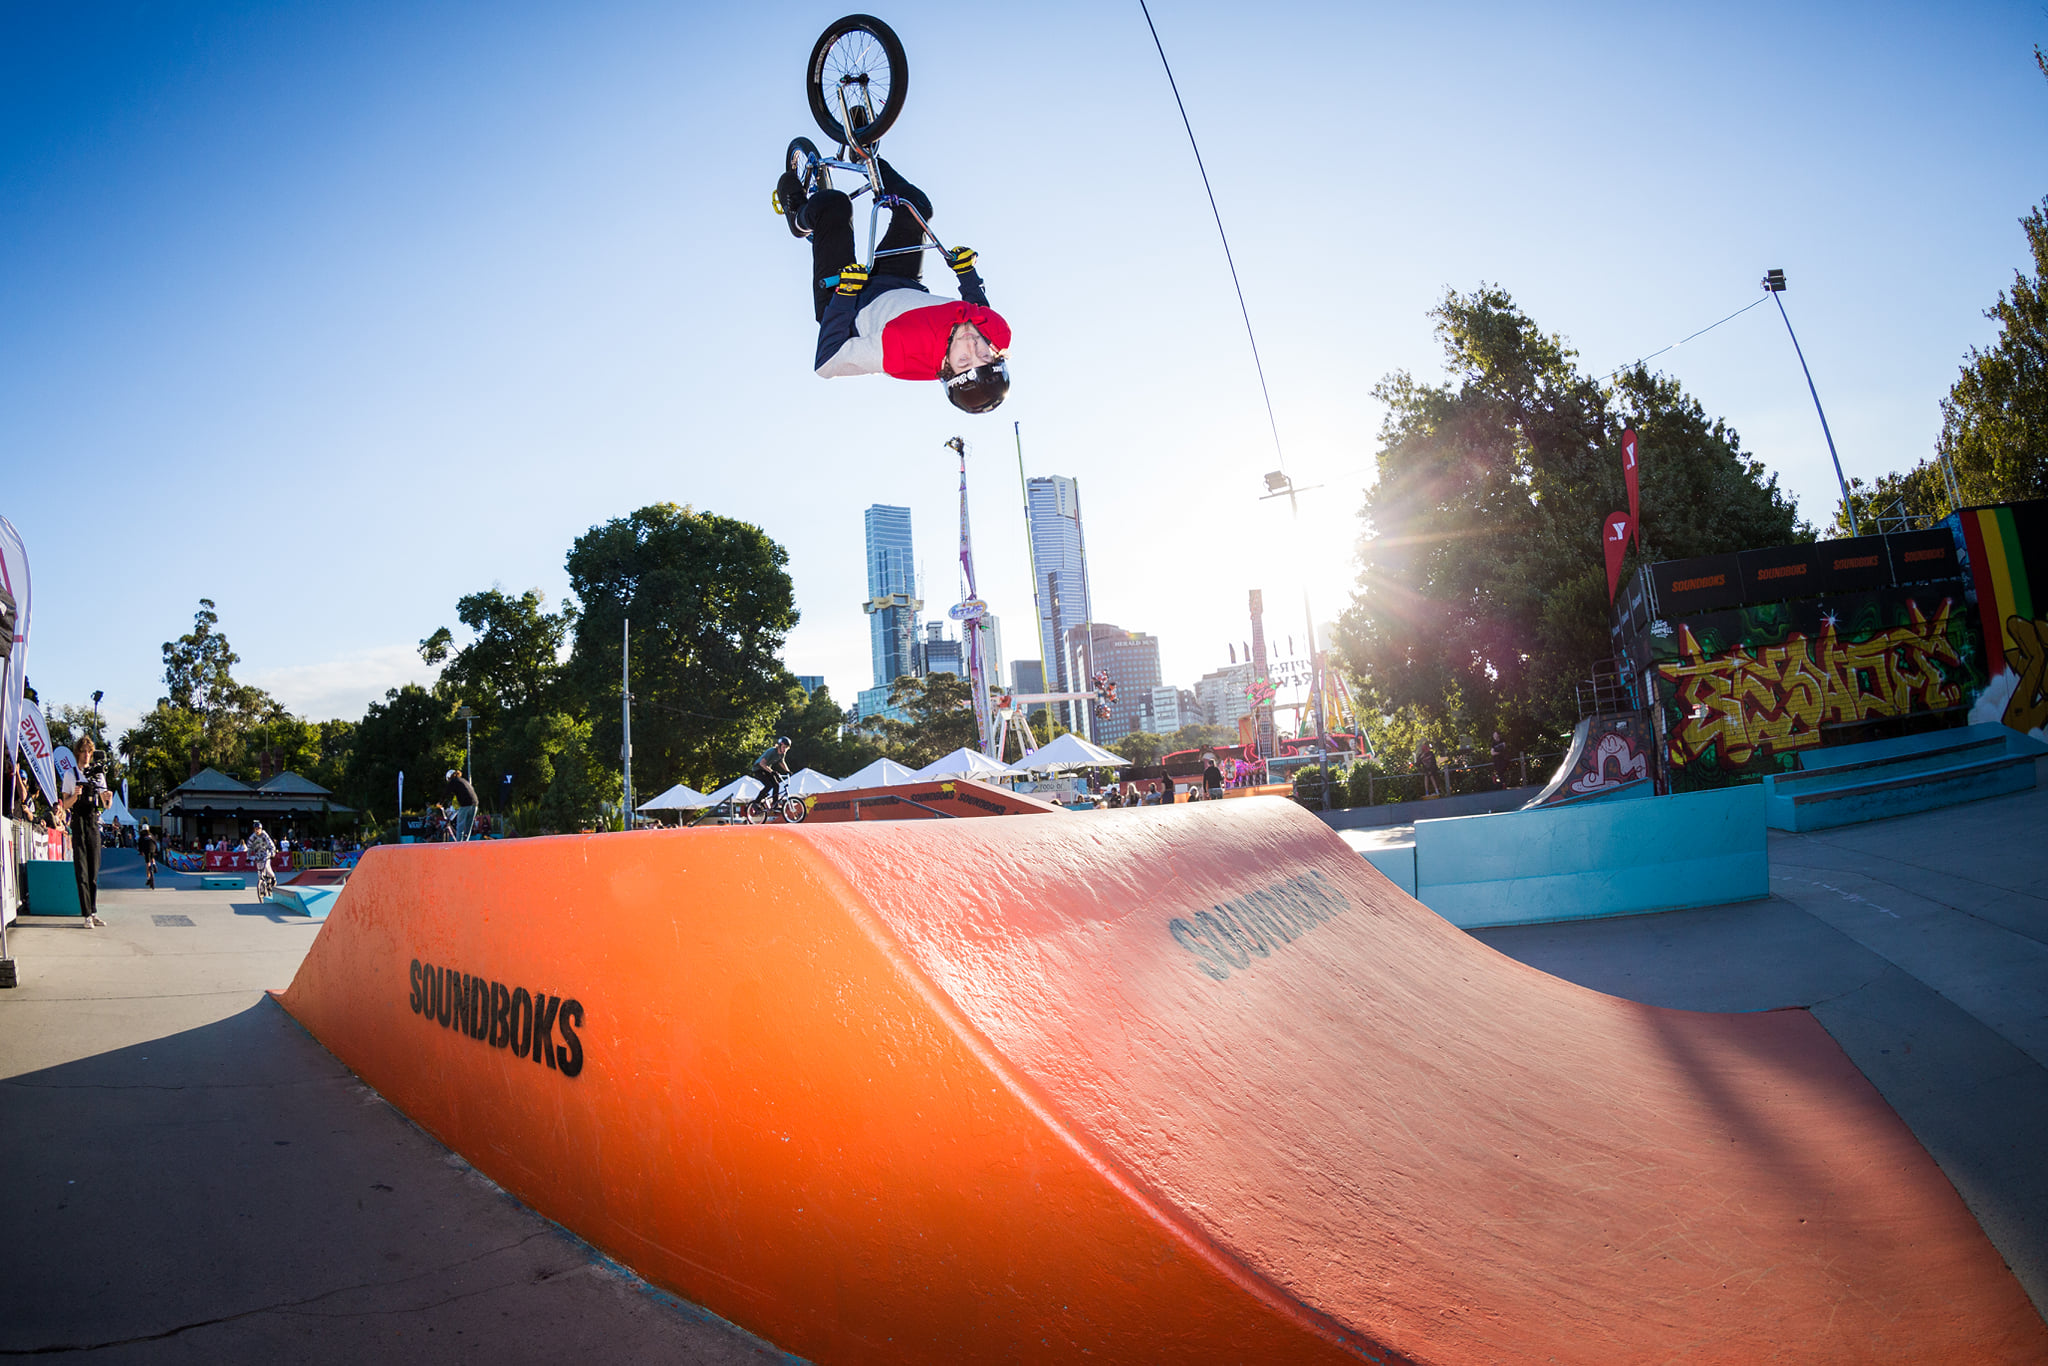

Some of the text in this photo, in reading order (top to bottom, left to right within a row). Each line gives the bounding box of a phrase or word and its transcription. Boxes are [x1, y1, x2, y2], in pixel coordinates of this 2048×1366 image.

[1833, 555, 1879, 570] SOUNDBOKS
[1757, 563, 1807, 580] SOUNDBOKS
[1671, 574, 1726, 592] SOUNDBOKS
[409, 959, 585, 1078] SOUNDBOKS
